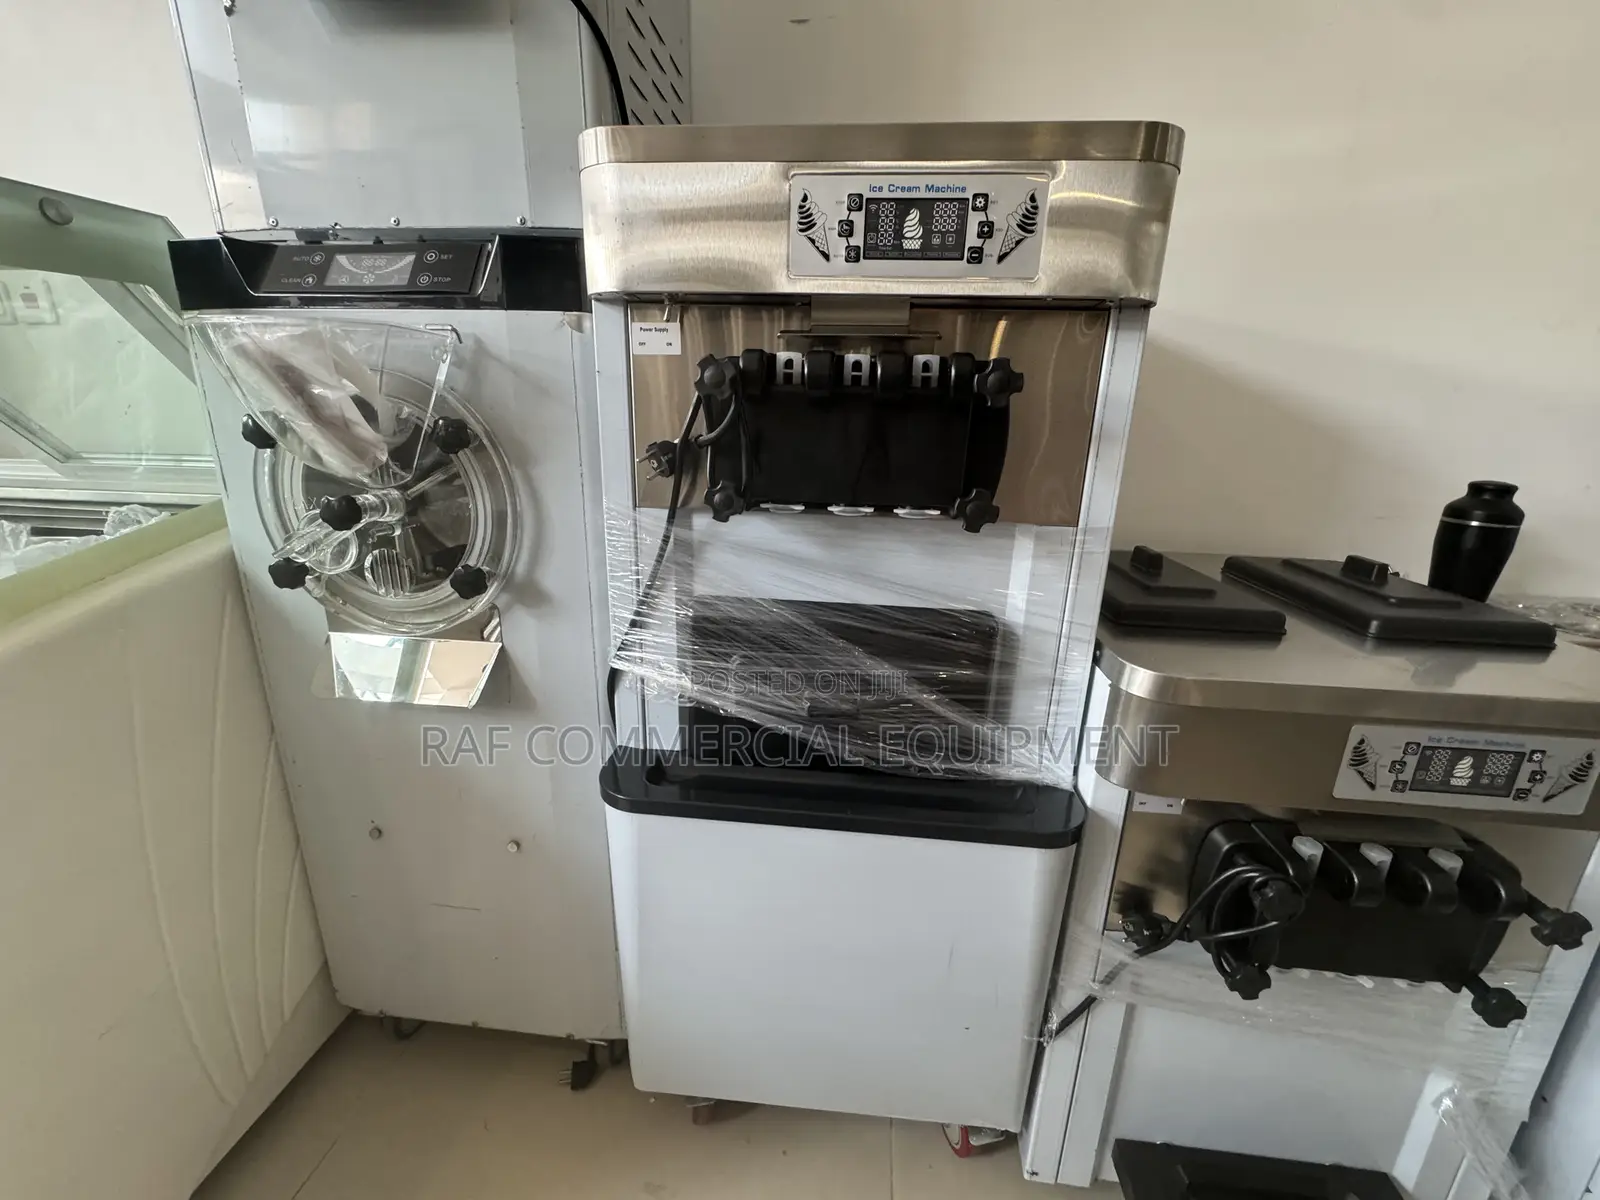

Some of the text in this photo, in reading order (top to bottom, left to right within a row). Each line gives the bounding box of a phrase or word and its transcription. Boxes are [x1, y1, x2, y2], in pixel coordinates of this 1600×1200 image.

[868, 184, 968, 193] Ice Cream Machine
[654, 326, 669, 334] Supply
